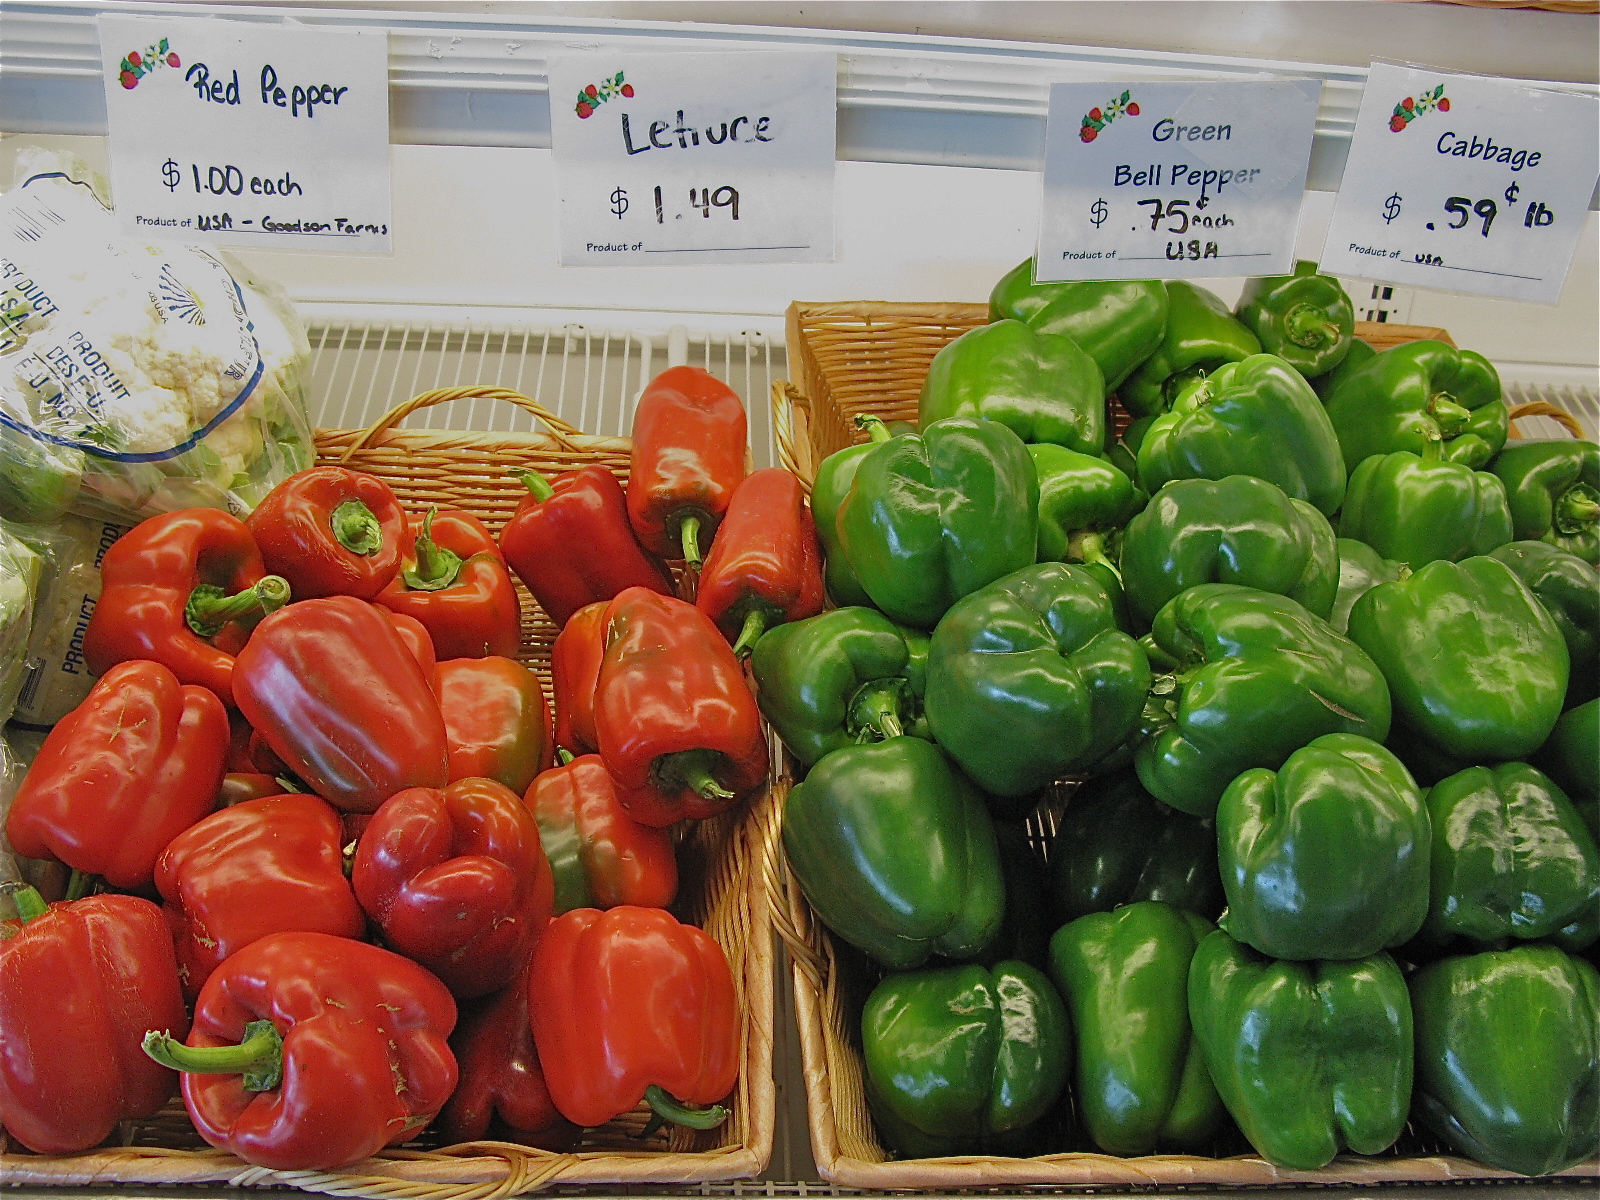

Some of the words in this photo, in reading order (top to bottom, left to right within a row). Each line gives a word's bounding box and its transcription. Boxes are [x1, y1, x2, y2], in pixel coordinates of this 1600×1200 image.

[185, 62, 241, 105] Red
[261, 64, 348, 118] Pepper
[1152, 117, 1232, 142] Green
[1436, 131, 1542, 171] Cabbage
[192, 164, 243, 195] 1.00
[250, 172, 303, 196] each
[1114, 164, 1162, 187] Bell
[1170, 164, 1261, 193] Pepper
[136, 215, 178, 227] Product
[180, 217, 192, 228] of
[197, 213, 232, 231] USA
[261, 215, 331, 233] Goodson
[1524, 201, 1554, 229] lb
[586, 242, 629, 252] Product
[631, 242, 643, 252] of
[1062, 251, 1103, 260] Product
[1105, 250, 1117, 259] of
[1165, 240, 1218, 261] USA
[1349, 243, 1388, 258] Product
[1389, 250, 1401, 260] of
[1414, 253, 1443, 266] USA
[67, 331, 131, 400] PRODUIT
